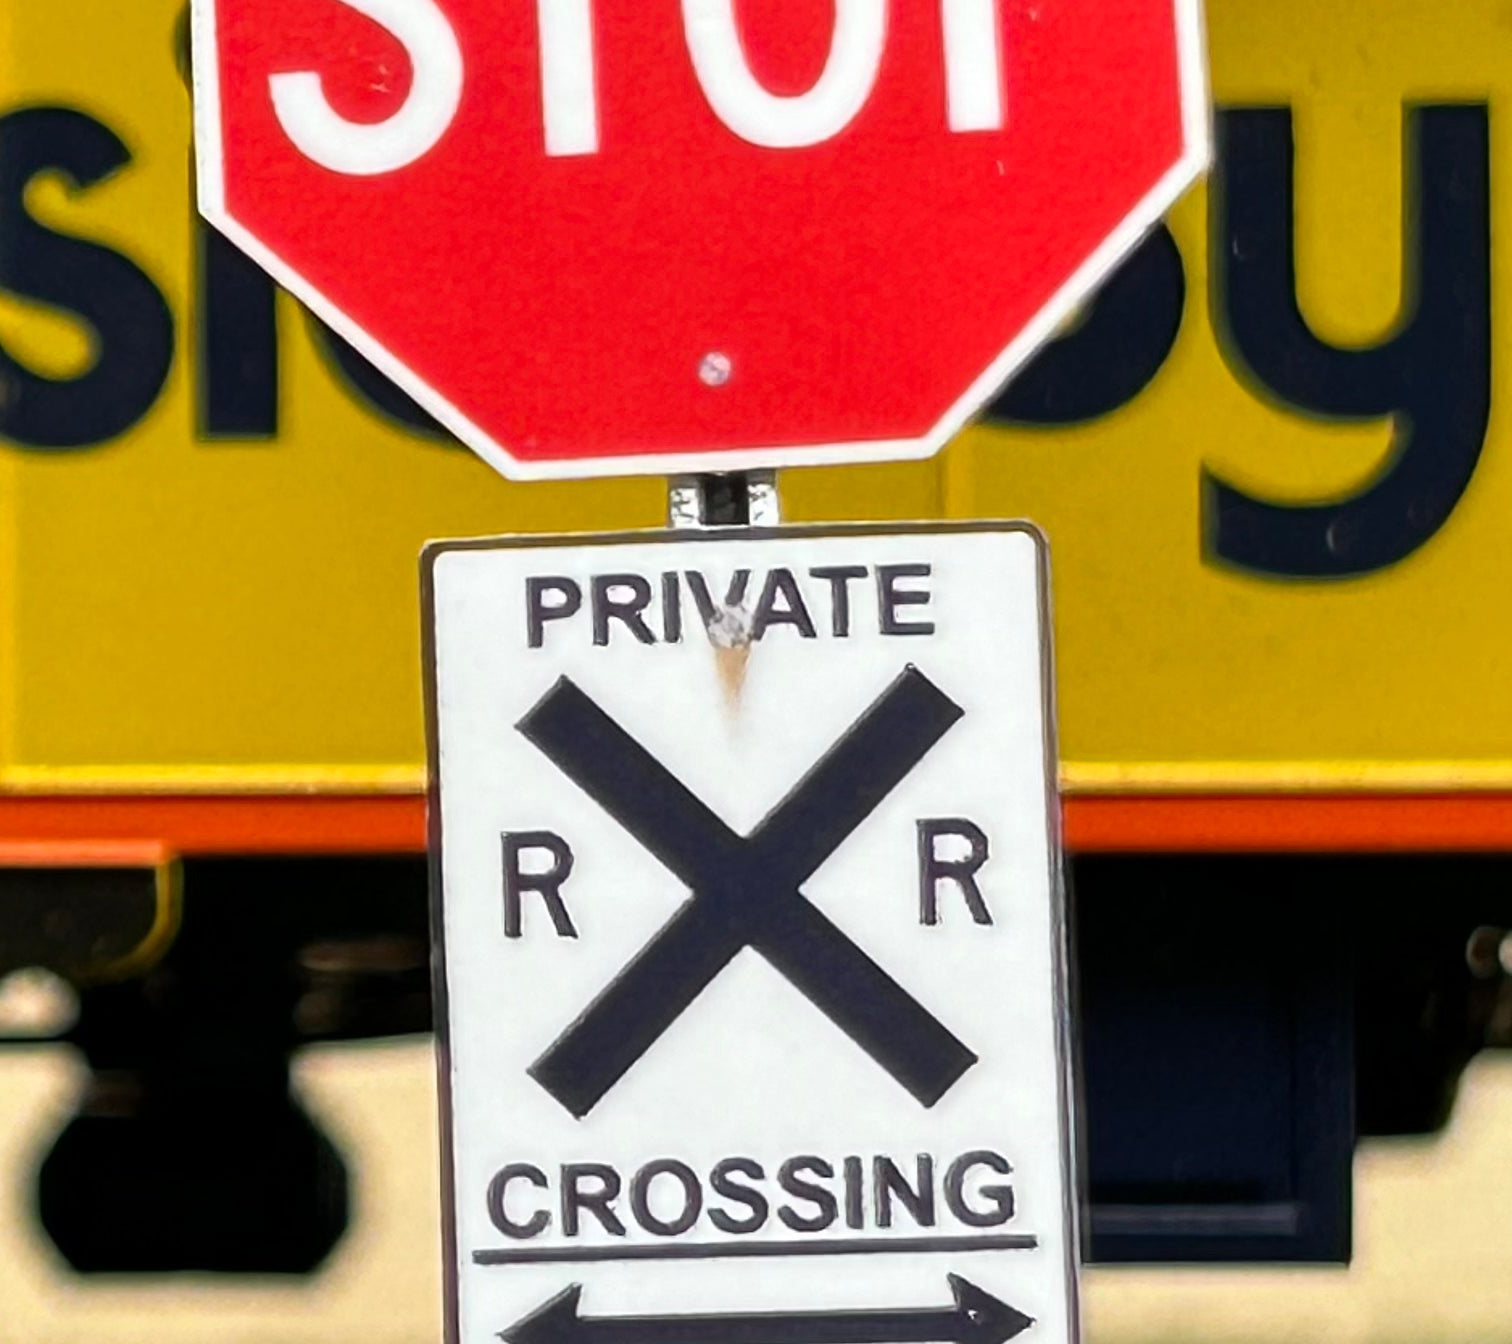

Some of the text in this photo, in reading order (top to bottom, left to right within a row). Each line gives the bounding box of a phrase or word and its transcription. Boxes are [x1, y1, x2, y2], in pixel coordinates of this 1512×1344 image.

[525, 561, 936, 649] PRIVATE
[499, 830, 578, 939] R
[915, 817, 994, 926] R
[486, 1147, 1016, 1240] CROSSING
